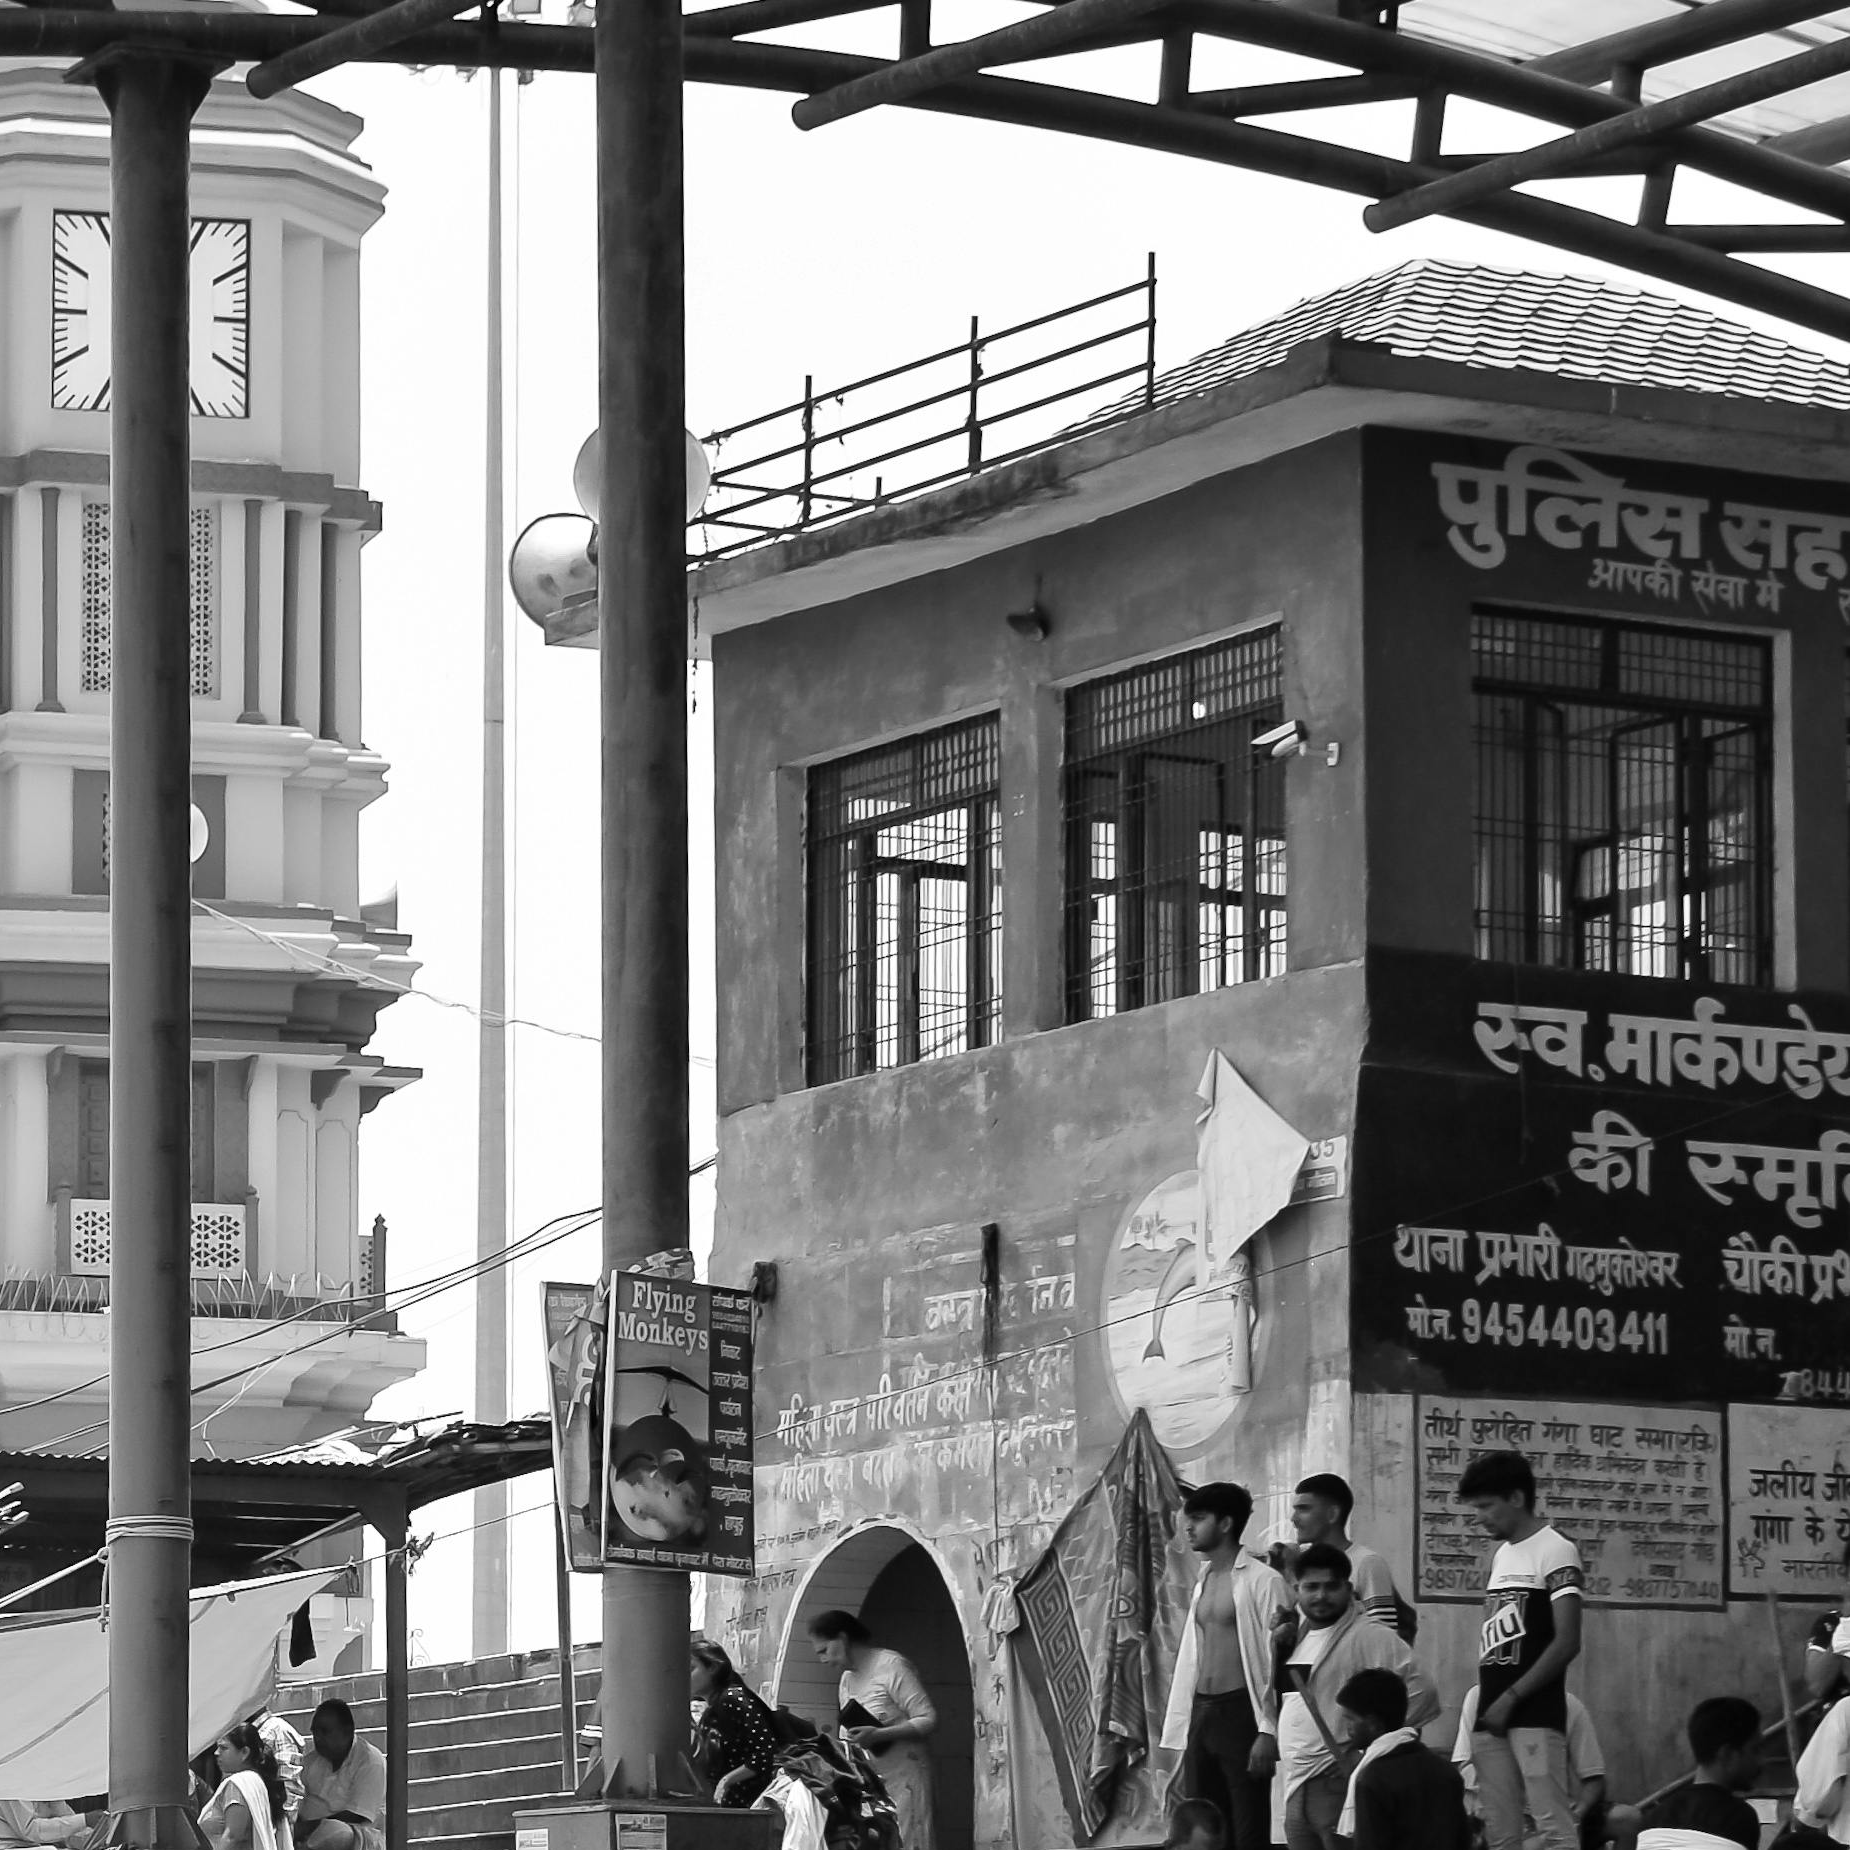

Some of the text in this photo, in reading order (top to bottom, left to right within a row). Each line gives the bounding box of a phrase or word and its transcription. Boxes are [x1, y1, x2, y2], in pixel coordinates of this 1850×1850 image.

[1431, 445, 1708, 569] पुलिस
[1587, 558, 1683, 602] आपकी
[1690, 562, 1747, 615] सेवा
[1568, 1110, 1655, 1197] की
[1393, 1224, 1469, 1273] थाना
[1475, 1222, 1562, 1286] प्रभारी
[1721, 1231, 1807, 1297] चौकी
[632, 1280, 697, 1323] Flying
[1461, 1298, 1669, 1355] 9454403411
[617, 1311, 709, 1356] Monkeys
[1470, 1410, 1536, 1446] पुरोहित
[1589, 1425, 1625, 1449] घाट
[1748, 1459, 1816, 1500] जलीय
[1750, 1508, 1795, 1545] गंगा
[1804, 1506, 1825, 1546] के
